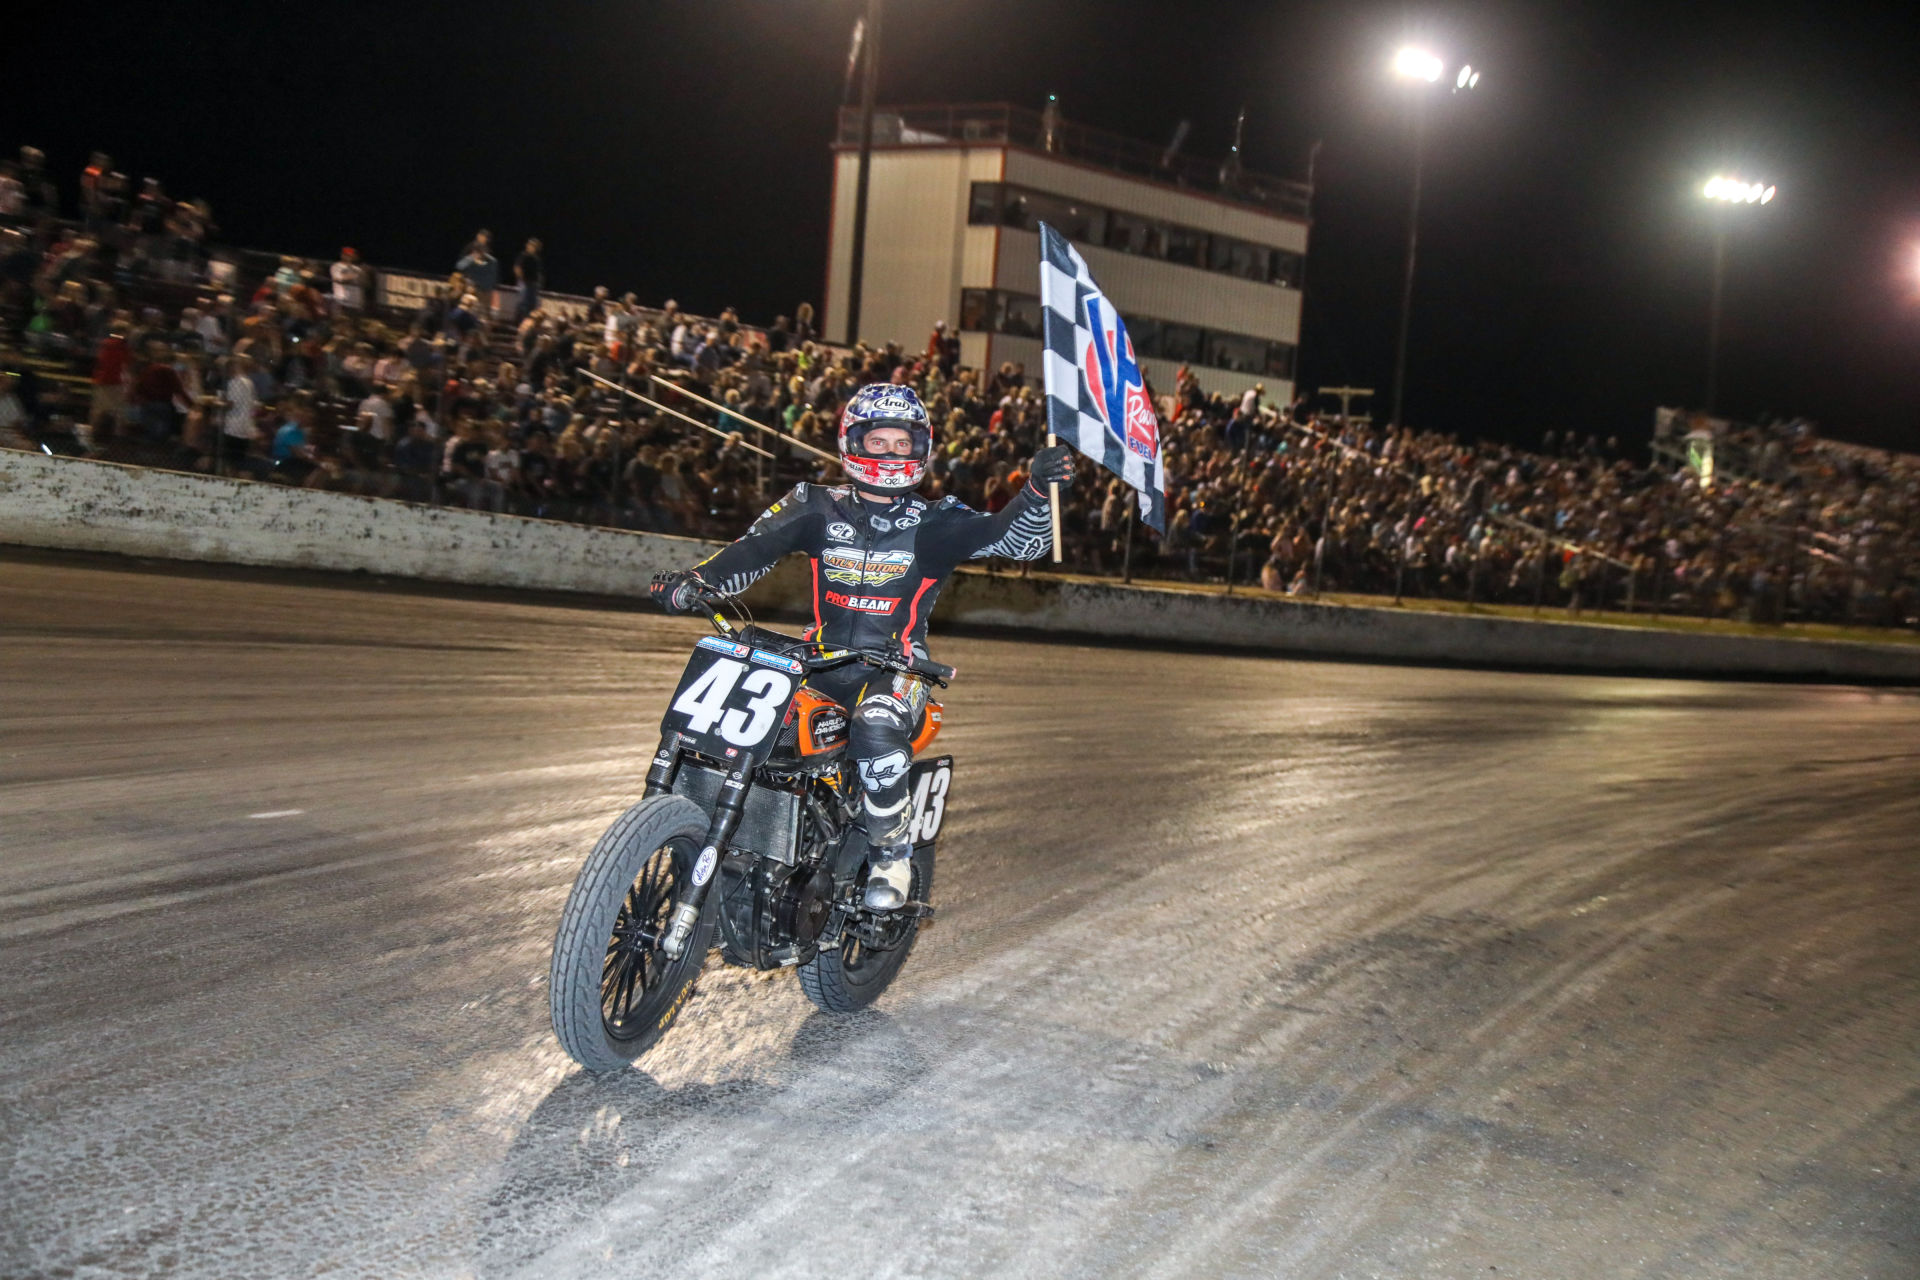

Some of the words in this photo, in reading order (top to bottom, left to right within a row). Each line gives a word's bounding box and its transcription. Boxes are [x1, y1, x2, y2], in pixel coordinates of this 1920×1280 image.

[881, 398, 906, 409] Arai
[825, 555, 856, 569] LATUS
[855, 561, 908, 574] MOTORS
[672, 657, 792, 747] 43
[908, 766, 951, 844] 43
